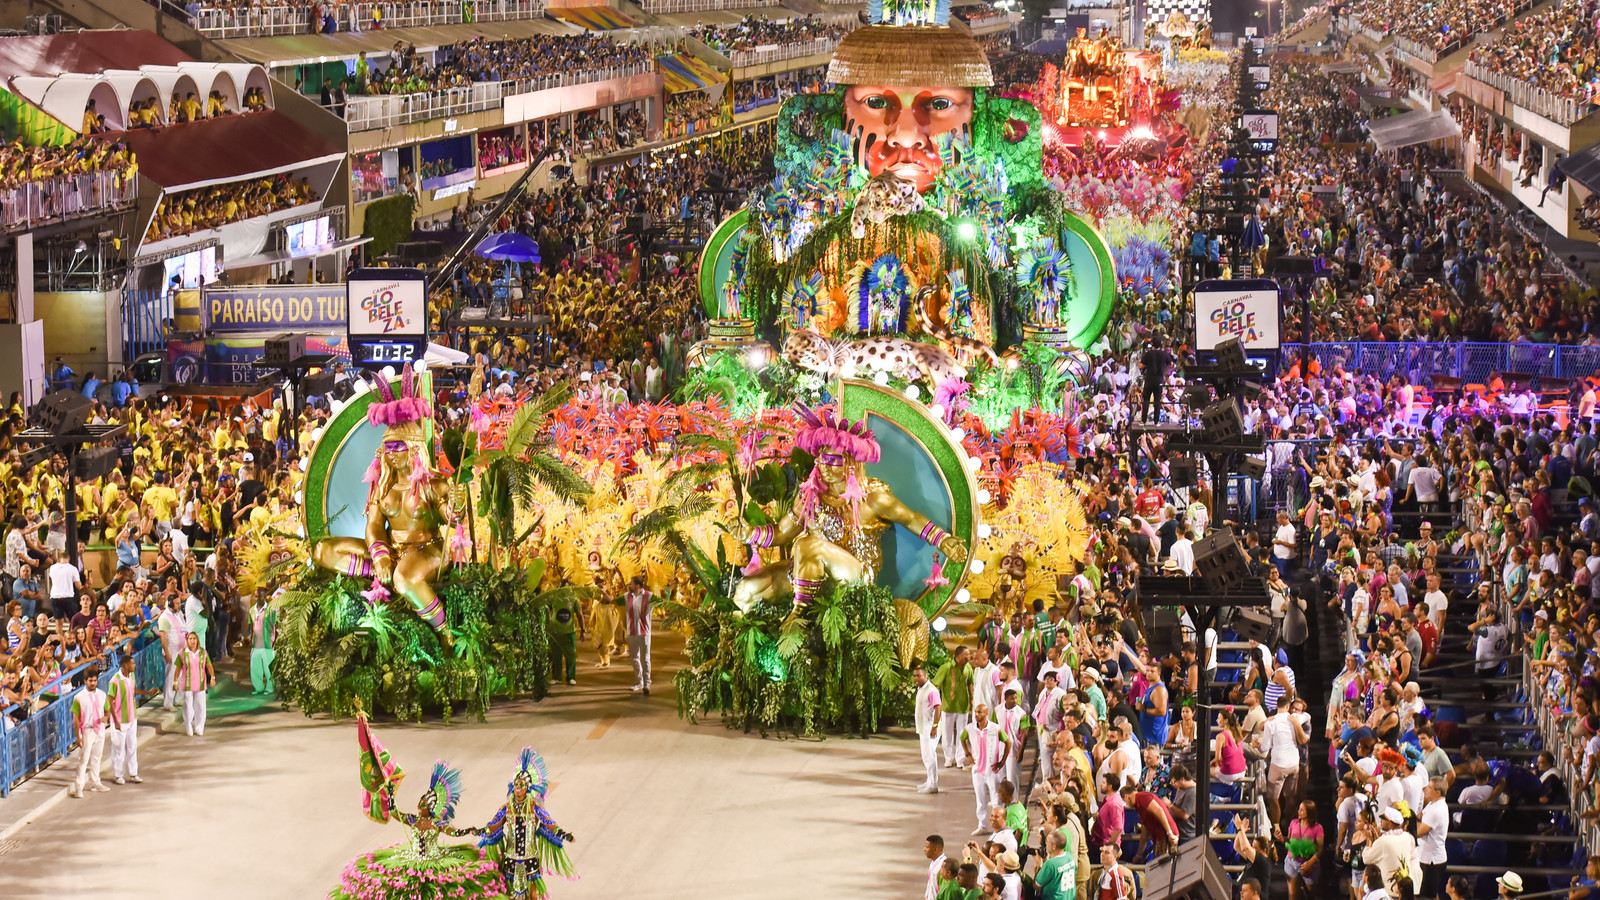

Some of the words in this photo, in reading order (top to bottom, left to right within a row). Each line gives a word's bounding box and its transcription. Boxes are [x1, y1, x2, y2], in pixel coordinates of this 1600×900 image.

[373, 282, 400, 294] CARNAVAL
[212, 293, 284, 323] PARAÍSO
[289, 297, 313, 322] DO
[317, 296, 345, 321] TUI
[361, 291, 393, 310] GLO
[1223, 294, 1252, 306] CARNAVAL
[369, 301, 403, 323] BELE
[1210, 302, 1245, 323] GLO
[383, 315, 405, 334] ZA
[1219, 312, 1255, 336] BELE
[373, 345, 414, 361] 0:32
[232, 371, 251, 383] DE
